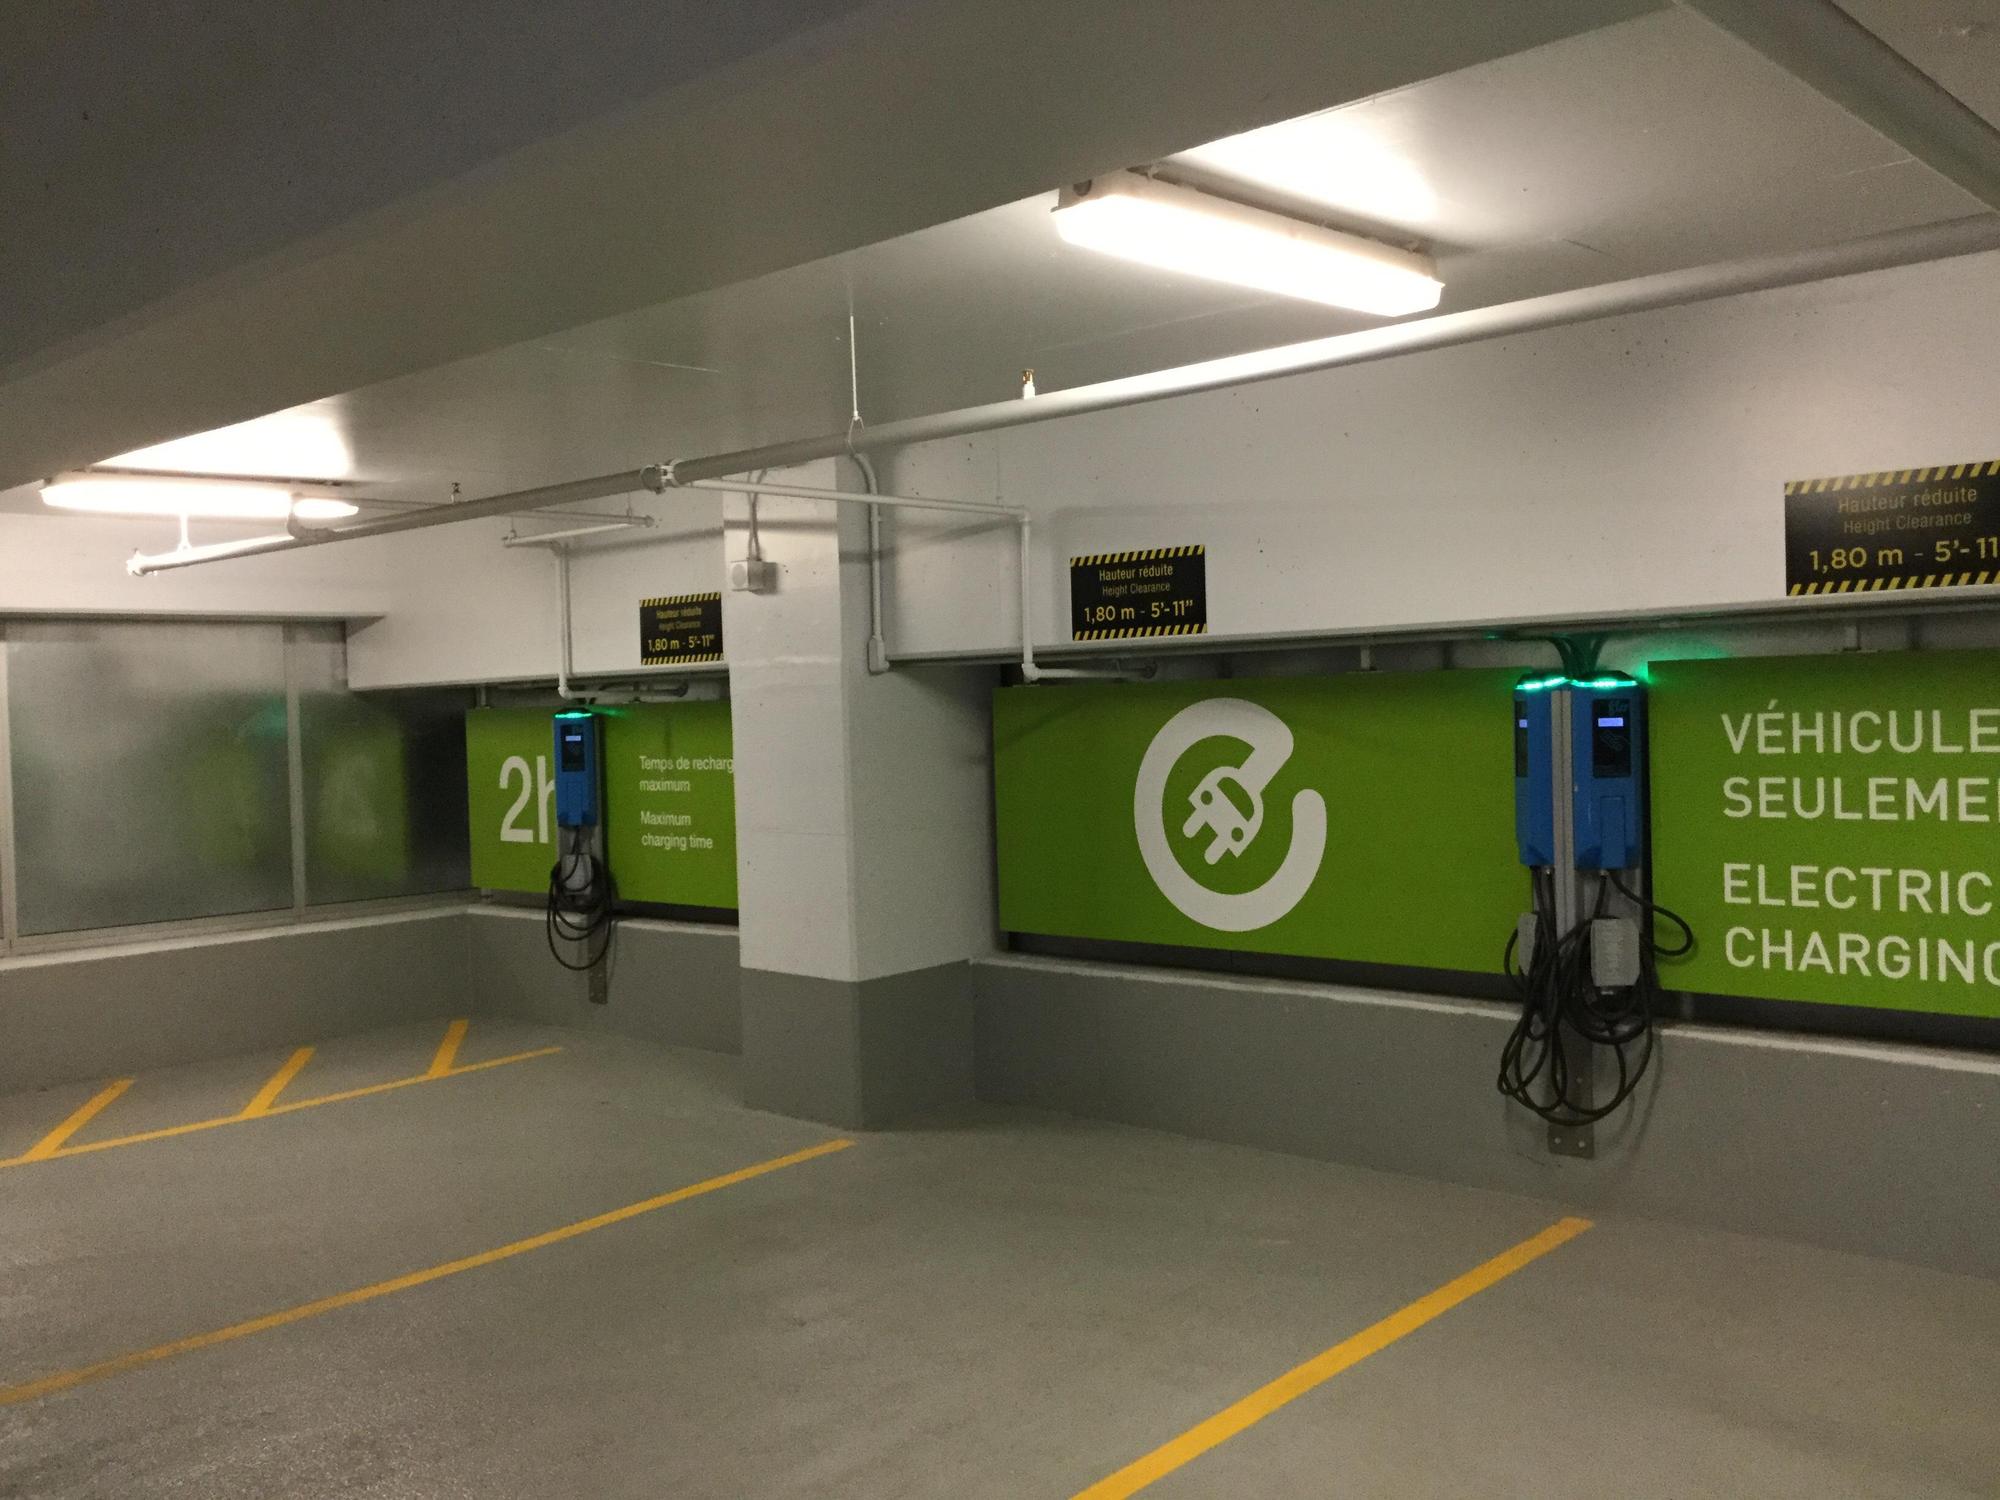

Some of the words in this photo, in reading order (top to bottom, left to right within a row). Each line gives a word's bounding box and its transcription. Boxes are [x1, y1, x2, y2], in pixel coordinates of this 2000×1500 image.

[1838, 494, 1907, 513] Hauteur
[1914, 486, 1977, 507] réduite
[1843, 519, 1891, 536] Height
[1896, 511, 1973, 531] Clearance
[1809, 547, 1867, 574] 1,80
[1878, 548, 1904, 566] m
[1099, 568, 1136, 582] Hauteur
[1139, 563, 1174, 578] réduite
[1102, 586, 1128, 598] Height
[1129, 582, 1171, 595] Clearance
[1084, 606, 1116, 624] 1,80
[1121, 607, 1135, 620] m
[648, 638, 668, 653] 1,80
[670, 639, 680, 650] m
[1721, 699, 2000, 754] VÉHICULE
[639, 755, 674, 773] Temps
[676, 756, 691, 770] de
[692, 756, 734, 774] recharg
[639, 777, 691, 792] maximum
[1723, 776, 2000, 822] SEULEME
[640, 810, 692, 826] Maximum
[641, 833, 687, 852] charging
[688, 834, 713, 849] time
[1723, 862, 1994, 916] ELECTRIC
